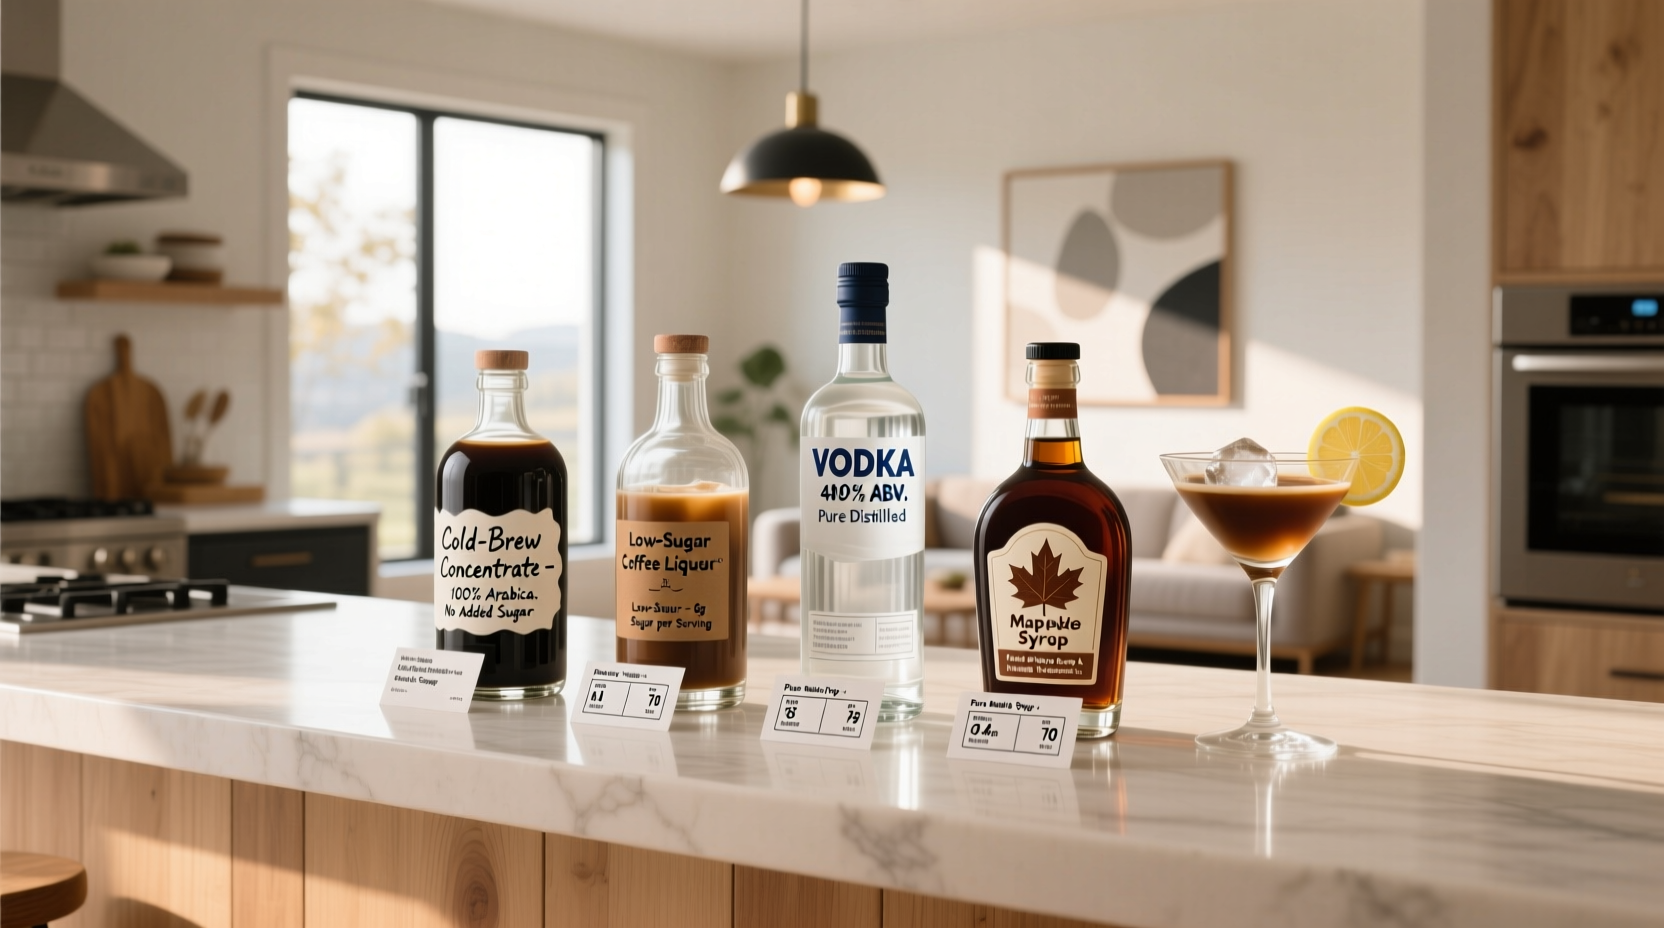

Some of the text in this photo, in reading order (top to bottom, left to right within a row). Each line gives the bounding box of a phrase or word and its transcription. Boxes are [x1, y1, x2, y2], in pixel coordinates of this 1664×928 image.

[812, 447, 915, 478] VODKA
[869, 483, 908, 502] ABV.
[818, 509, 846, 523] Pure
[442, 525, 541, 552] Cold-Brew
[629, 531, 711, 553] Low-Sugar
[441, 556, 540, 578] Concentrate
[622, 553, 660, 571] Coffee
[451, 586, 538, 602] 100% Arabica.
[444, 603, 534, 623] No Added Sugar
[657, 620, 673, 632] per
[1018, 630, 1069, 650] Syrop
[648, 694, 661, 707] 70
[1041, 727, 1058, 742] 70
